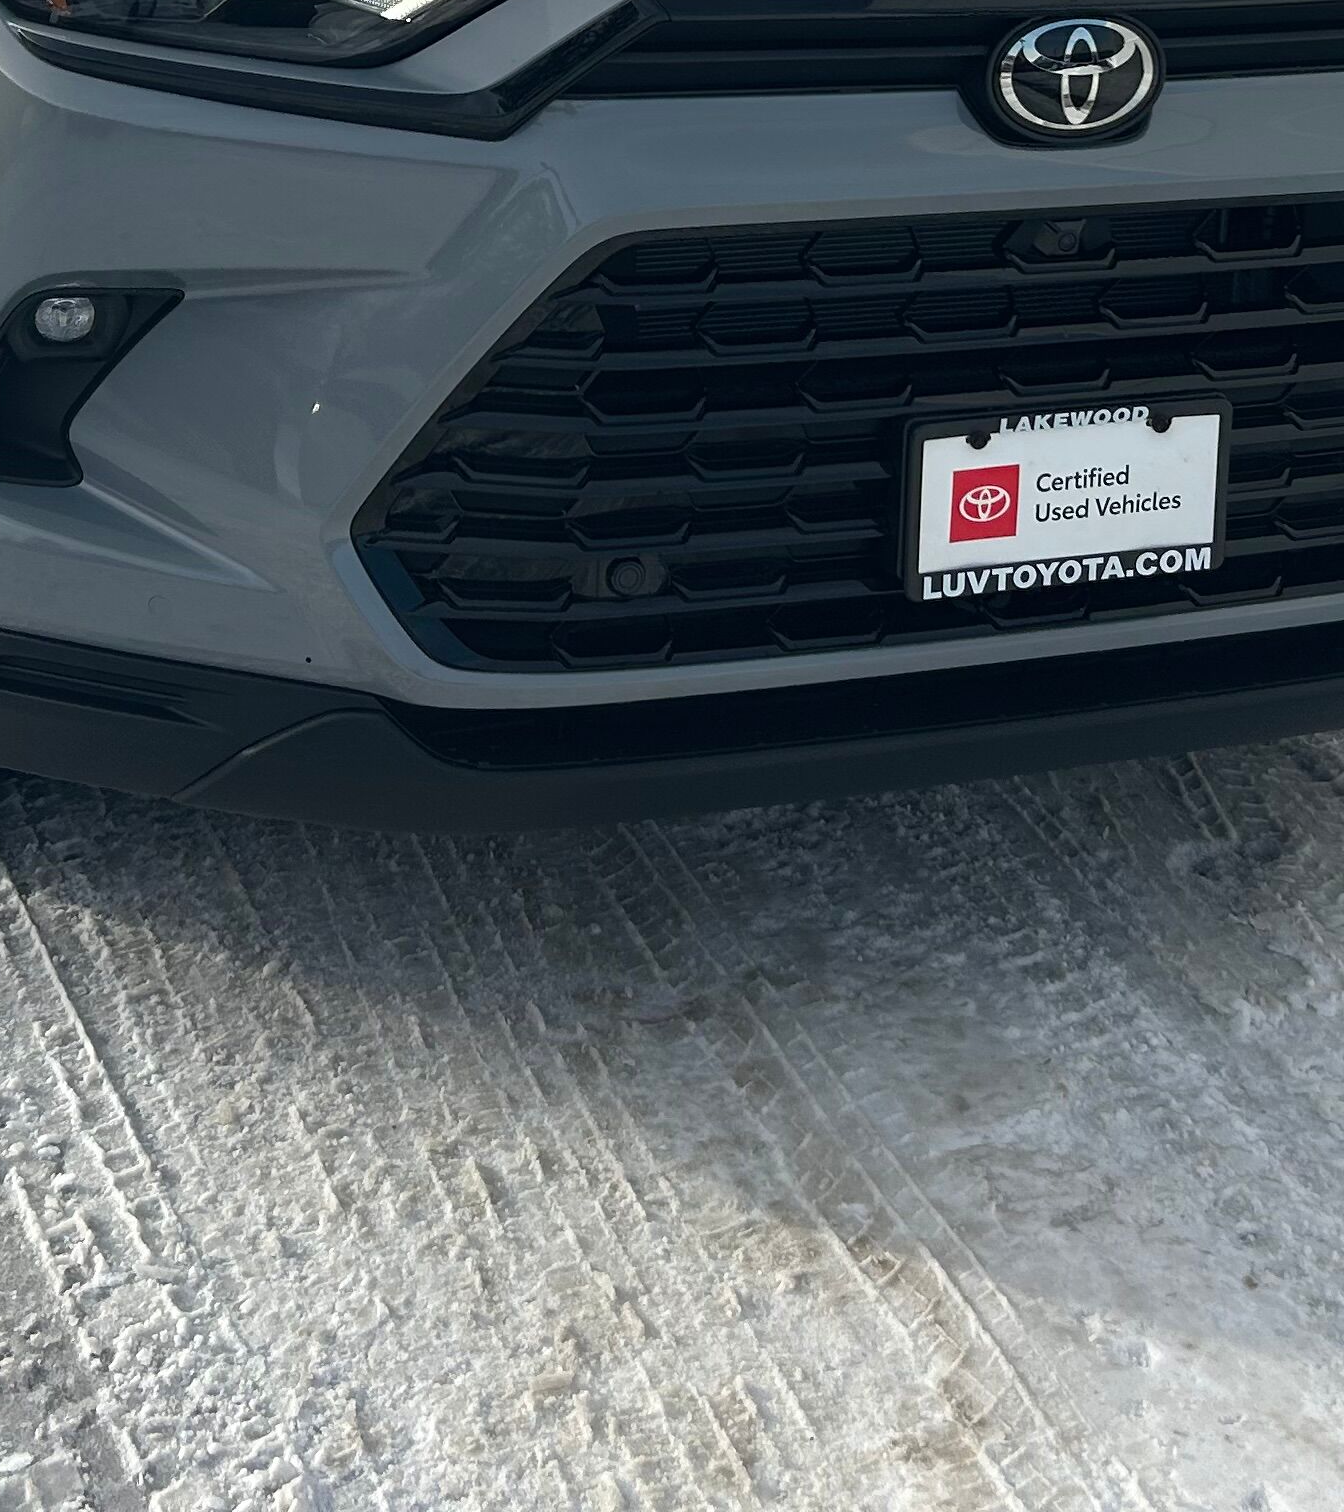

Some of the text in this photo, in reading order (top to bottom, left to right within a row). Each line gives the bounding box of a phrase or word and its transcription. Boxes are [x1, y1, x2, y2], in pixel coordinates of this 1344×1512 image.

[999, 405, 1150, 434] LAKEWOOD
[1036, 465, 1129, 492] Certified
[1035, 491, 1182, 522] Used Vehicles
[922, 546, 1212, 601] LUVTOYOTA.COM
